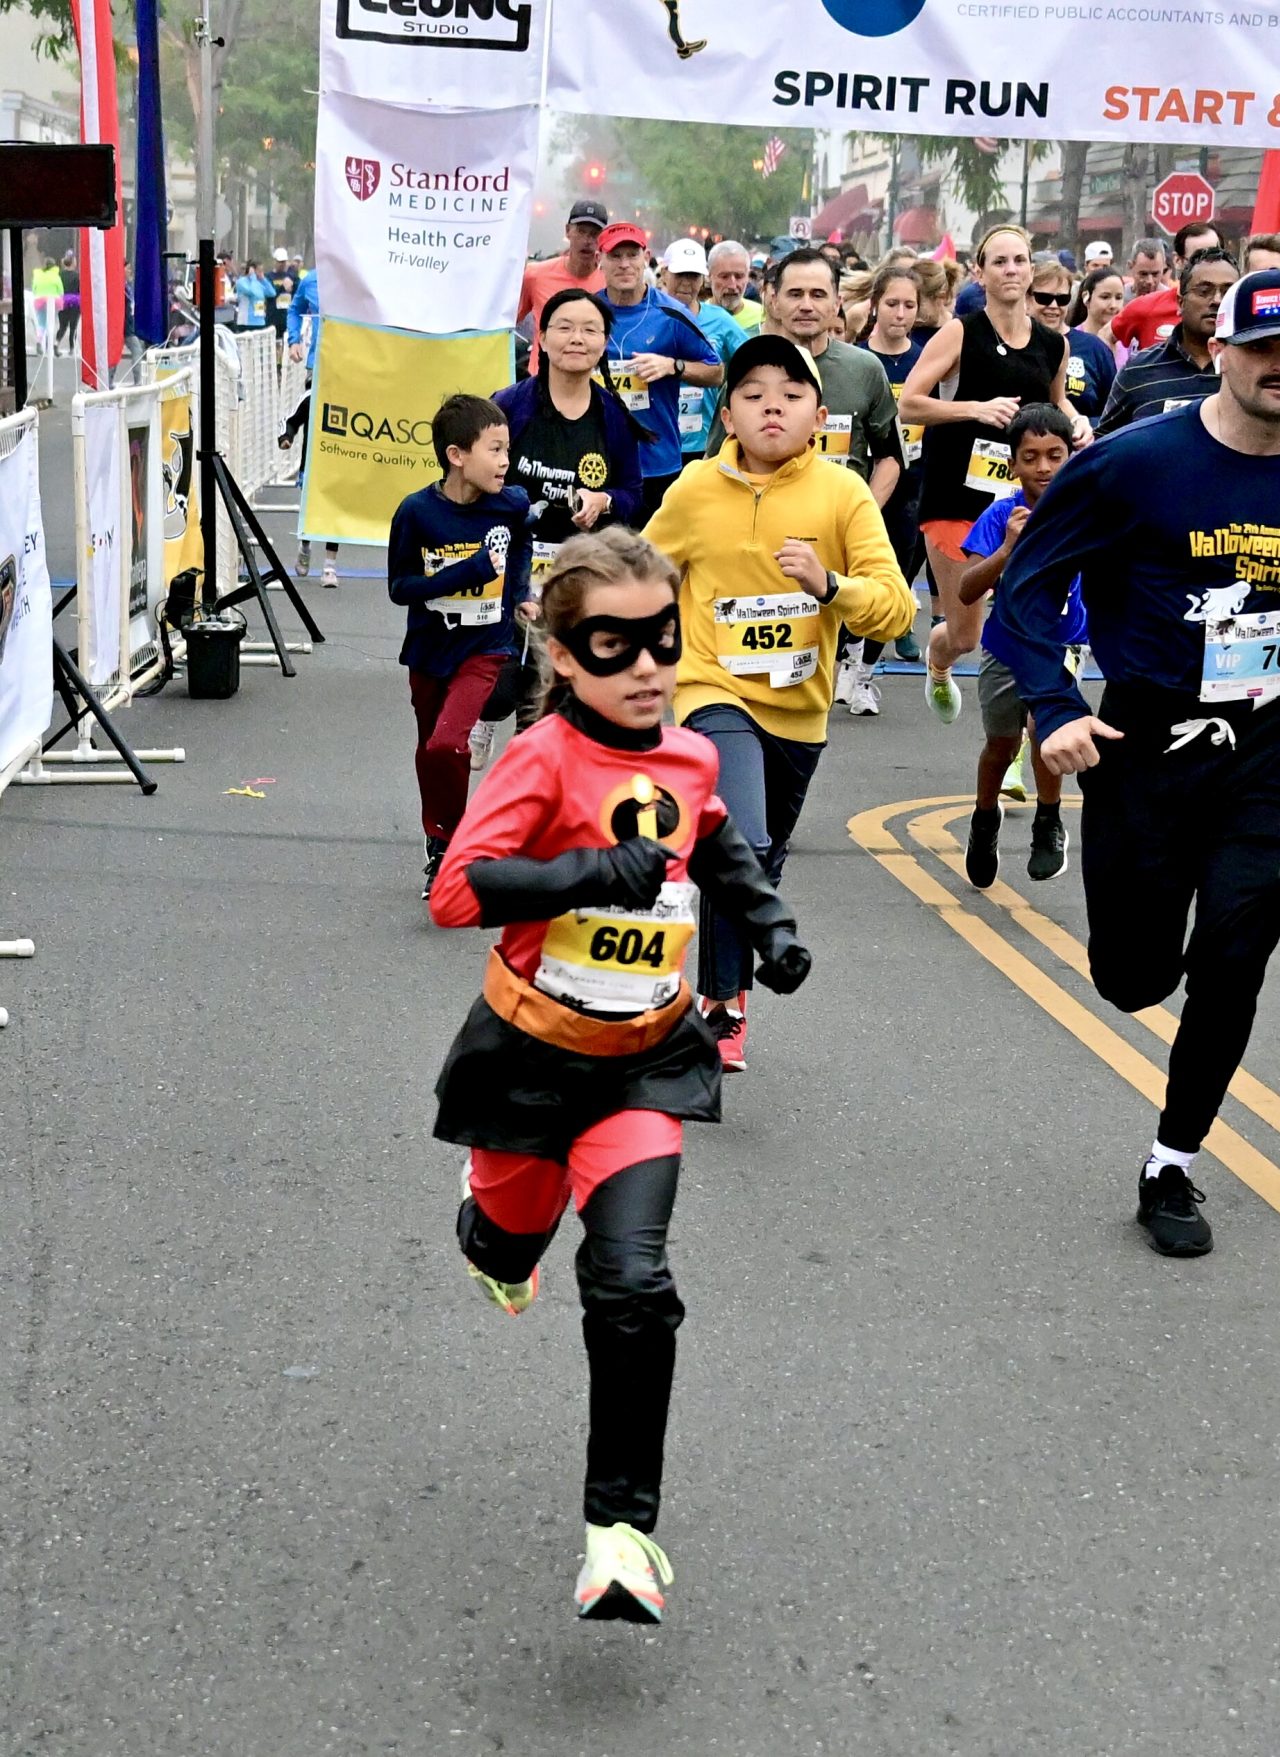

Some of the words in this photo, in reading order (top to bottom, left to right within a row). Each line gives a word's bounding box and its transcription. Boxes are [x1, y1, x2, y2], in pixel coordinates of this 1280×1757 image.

[957, 3, 1039, 19] CERTIFIED
[1044, 6, 1103, 20] PUBLIC
[1109, 8, 1224, 25] ACCOUNTANTS
[1229, 13, 1263, 27] AND
[403, 21, 469, 35] STUDIO
[772, 70, 930, 113] SPIRIT
[944, 79, 1049, 118] RUN
[1102, 85, 1255, 127] START
[390, 163, 510, 192] Stanford
[388, 192, 509, 213] MEDICINE
[1158, 193, 1209, 216] STOP
[388, 226, 447, 248] Health
[453, 232, 491, 249] Care
[387, 251, 449, 274] Tri-Valley
[320, 441, 368, 460] Software
[373, 452, 416, 469] Quality
[737, 608, 776, 619] Halloween
[777, 604, 801, 617] Spirit
[802, 602, 818, 614] Run
[741, 623, 794, 650] 452
[1235, 625, 1275, 640] Halloween
[1215, 654, 1241, 669] VIP
[590, 926, 666, 969] 604
